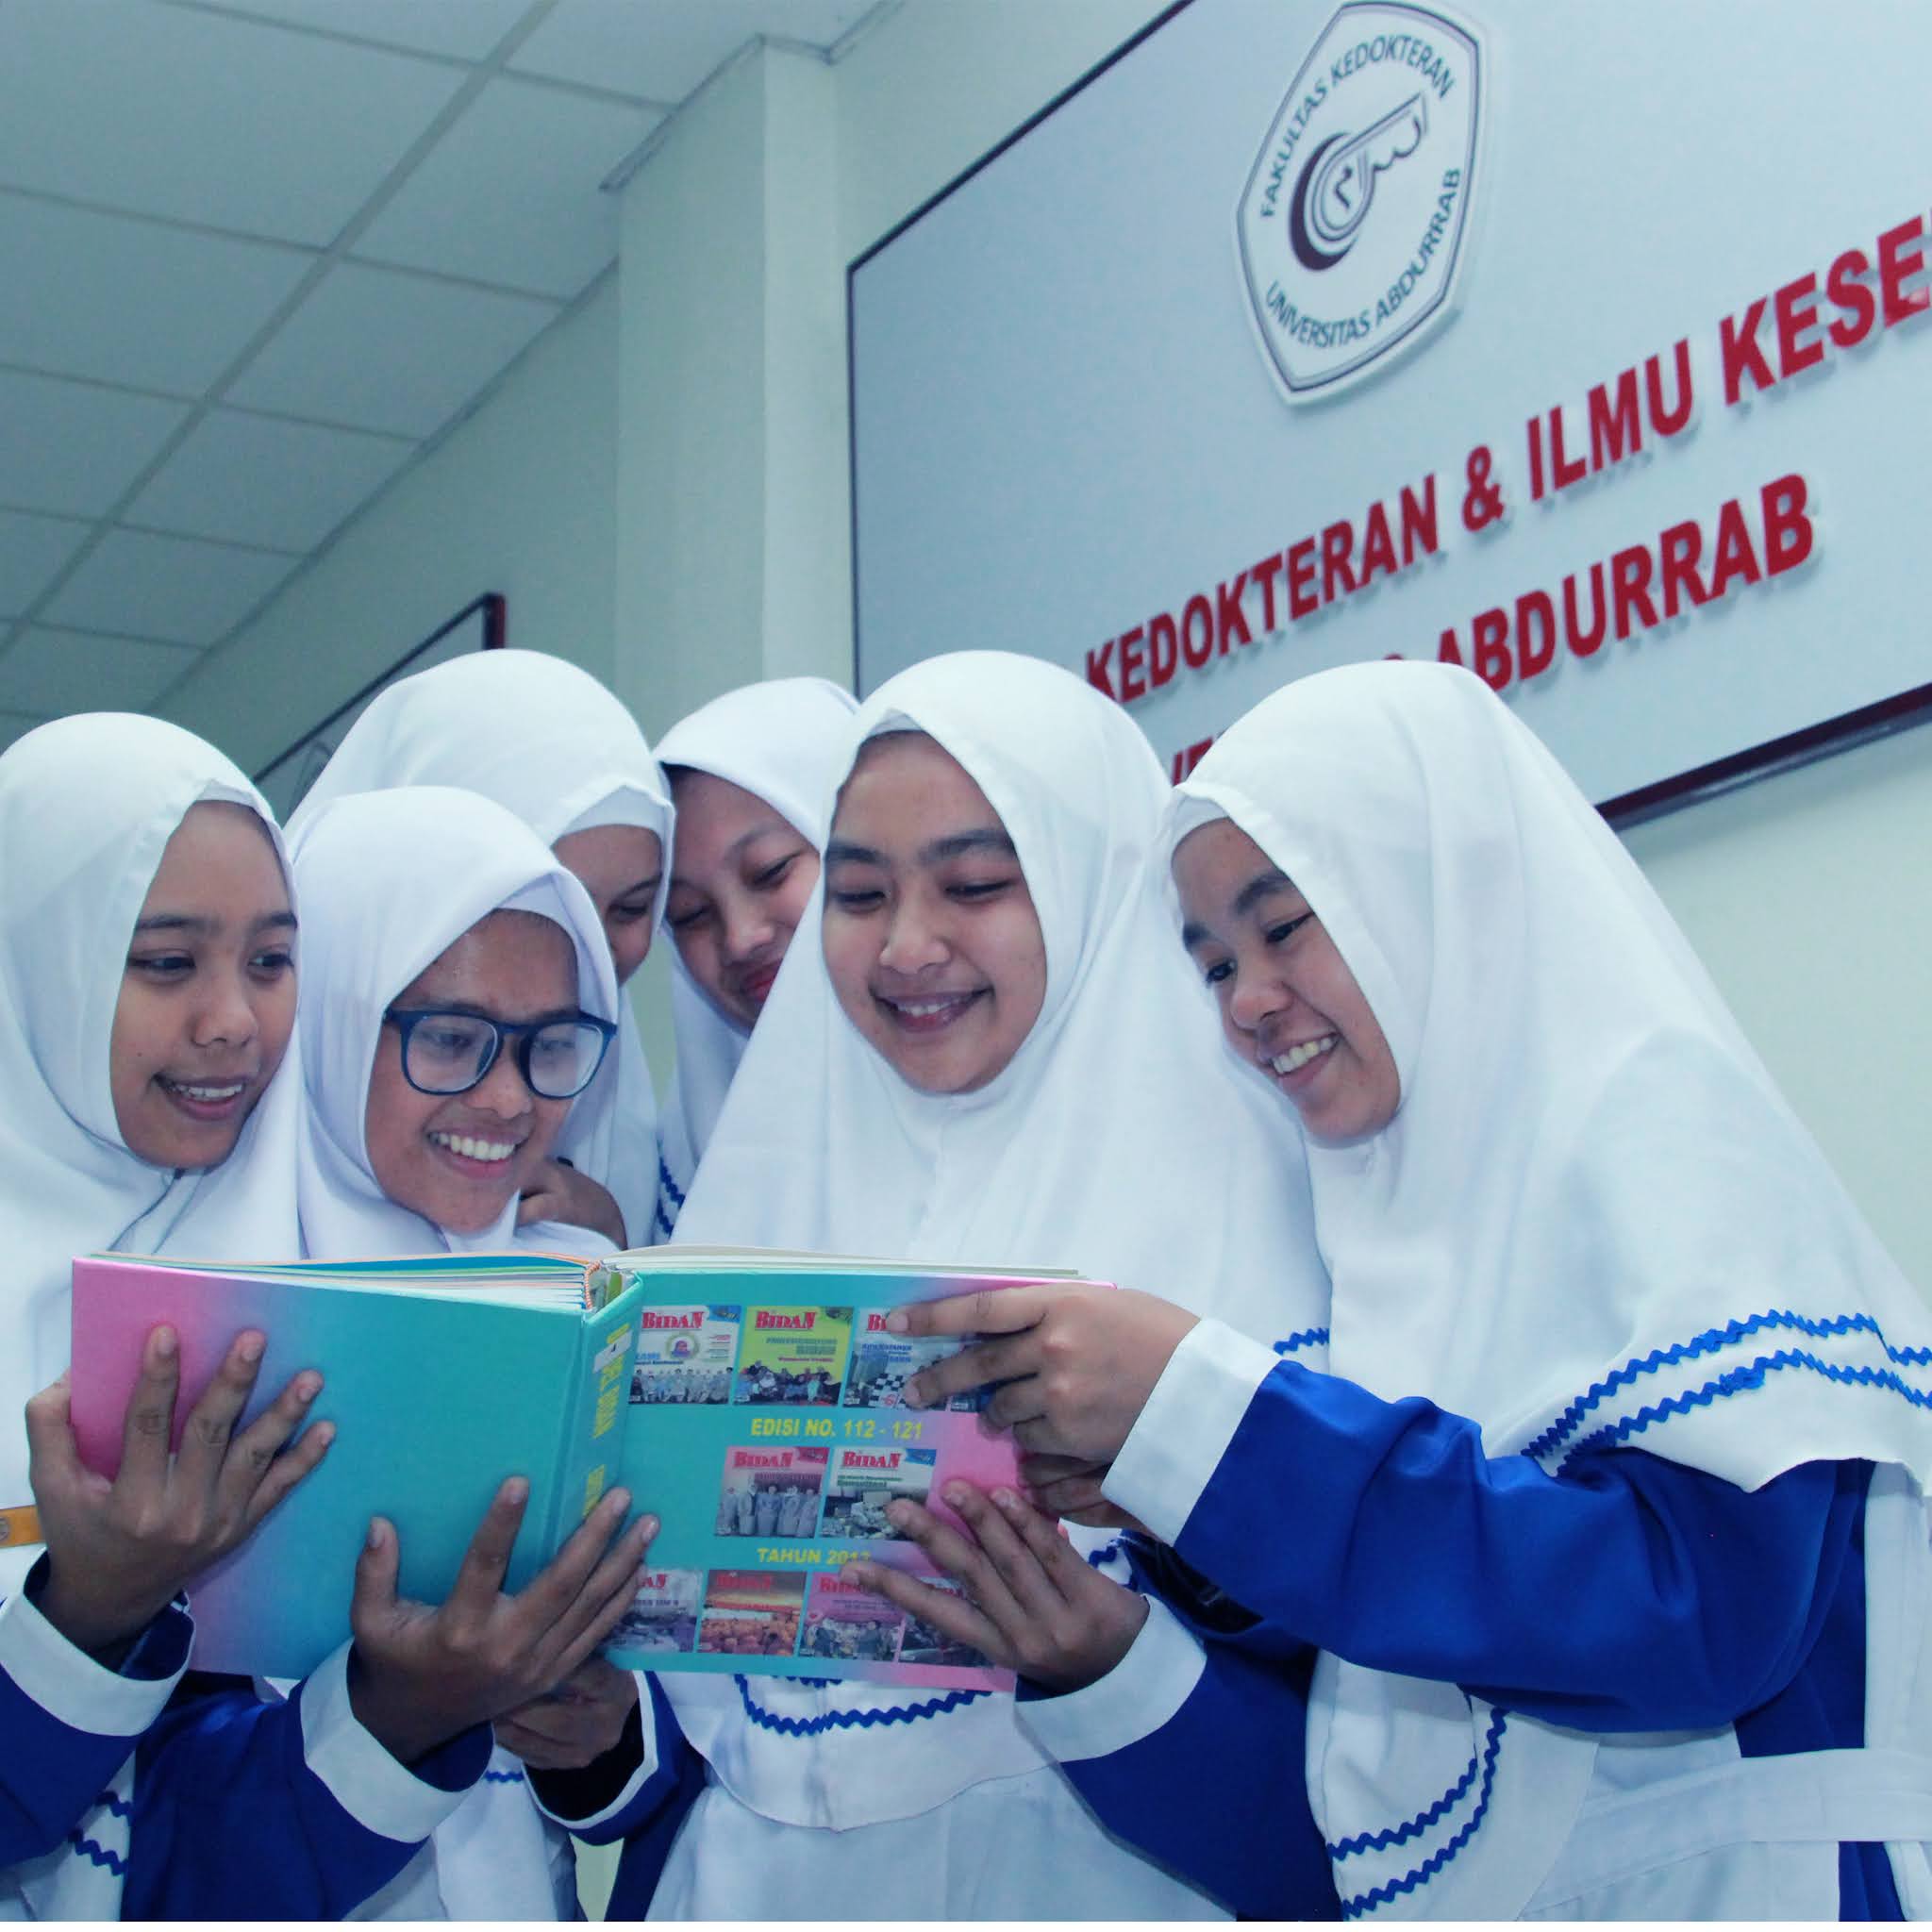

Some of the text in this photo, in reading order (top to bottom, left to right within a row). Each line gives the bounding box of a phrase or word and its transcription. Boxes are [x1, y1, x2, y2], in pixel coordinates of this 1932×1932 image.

[1259, 34, 1457, 219] FAKULTAS KEDOKTERAN
[1265, 168, 1461, 349] UNIVERSITAS ABDURRAB
[1087, 212, 1932, 704] KEDOKTERAN & ILMU KESE
[750, 1418, 801, 1437] EDISI
[805, 1420, 836, 1438] NO.
[844, 1420, 876, 1439] 112
[892, 1422, 923, 1441] 121
[757, 1547, 822, 1563] TAHUN
